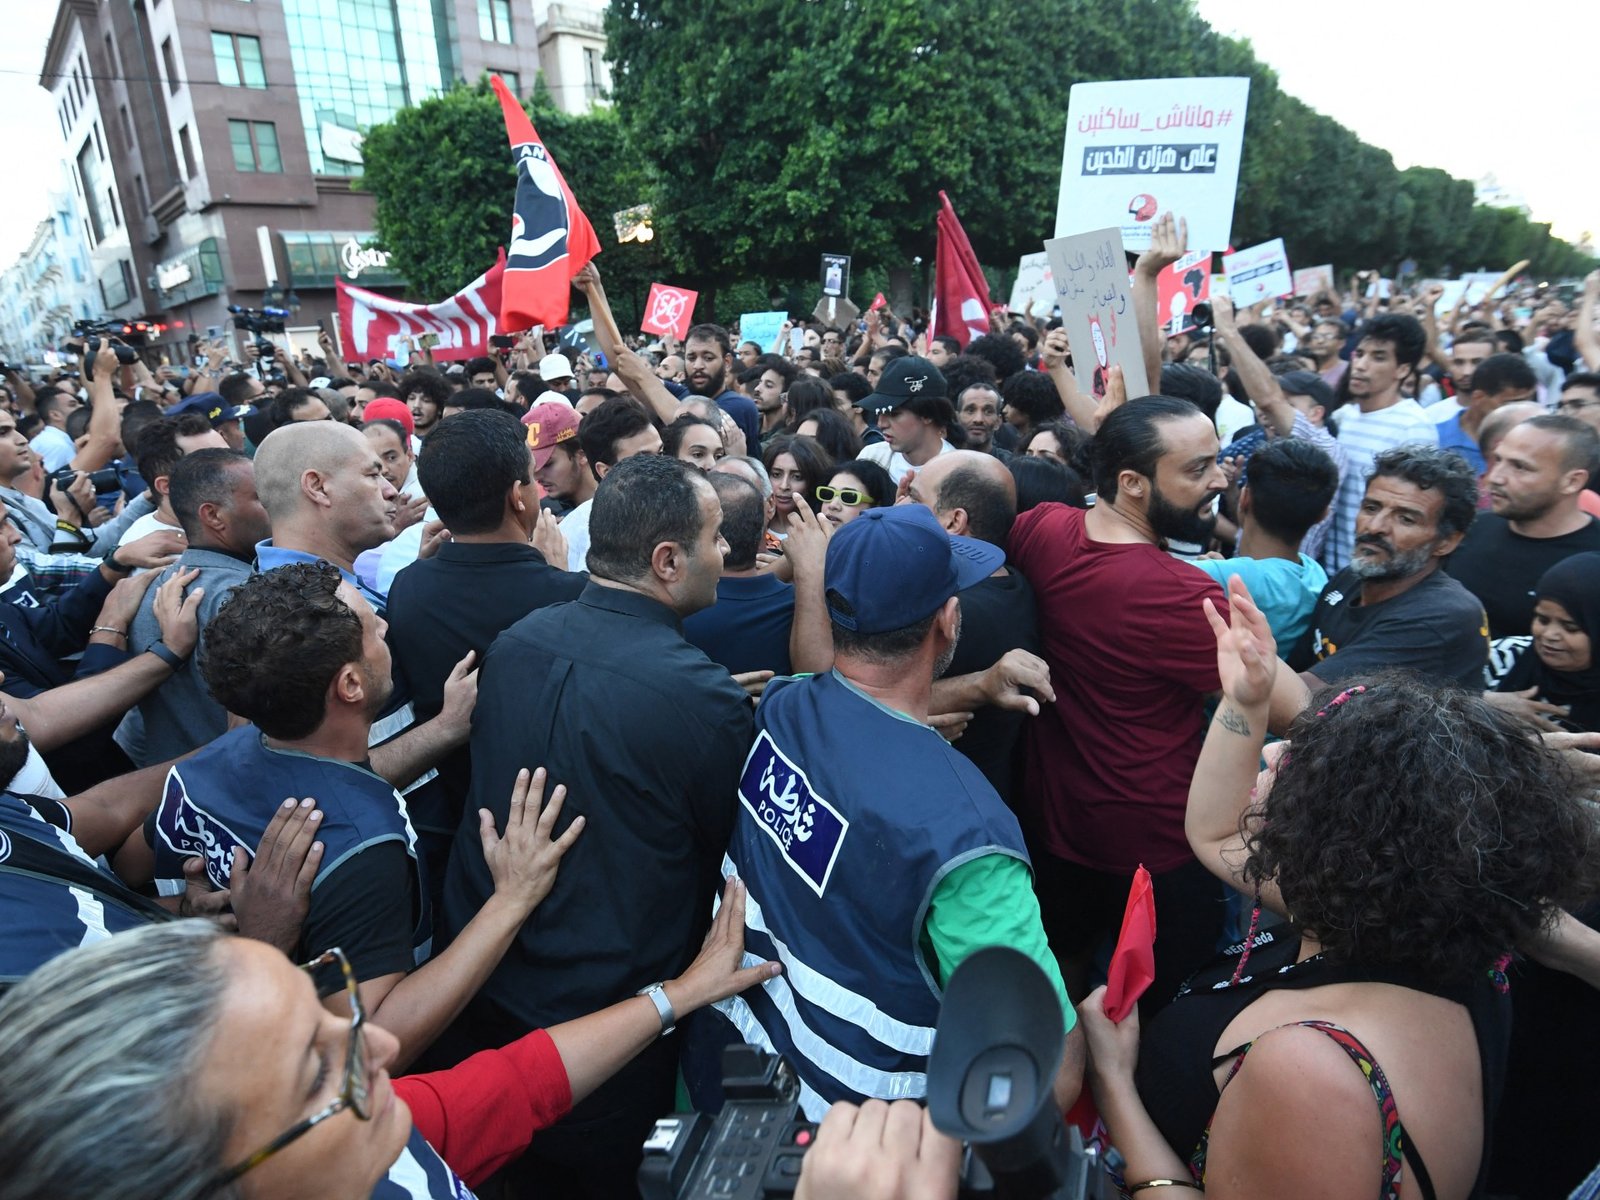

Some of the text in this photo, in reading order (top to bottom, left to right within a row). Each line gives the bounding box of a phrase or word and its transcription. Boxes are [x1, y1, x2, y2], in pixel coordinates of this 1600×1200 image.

[344, 272, 497, 355] FIGHT
[758, 800, 794, 851] POLICE
[759, 755, 816, 842] شرطة
[181, 839, 222, 883] POCE
